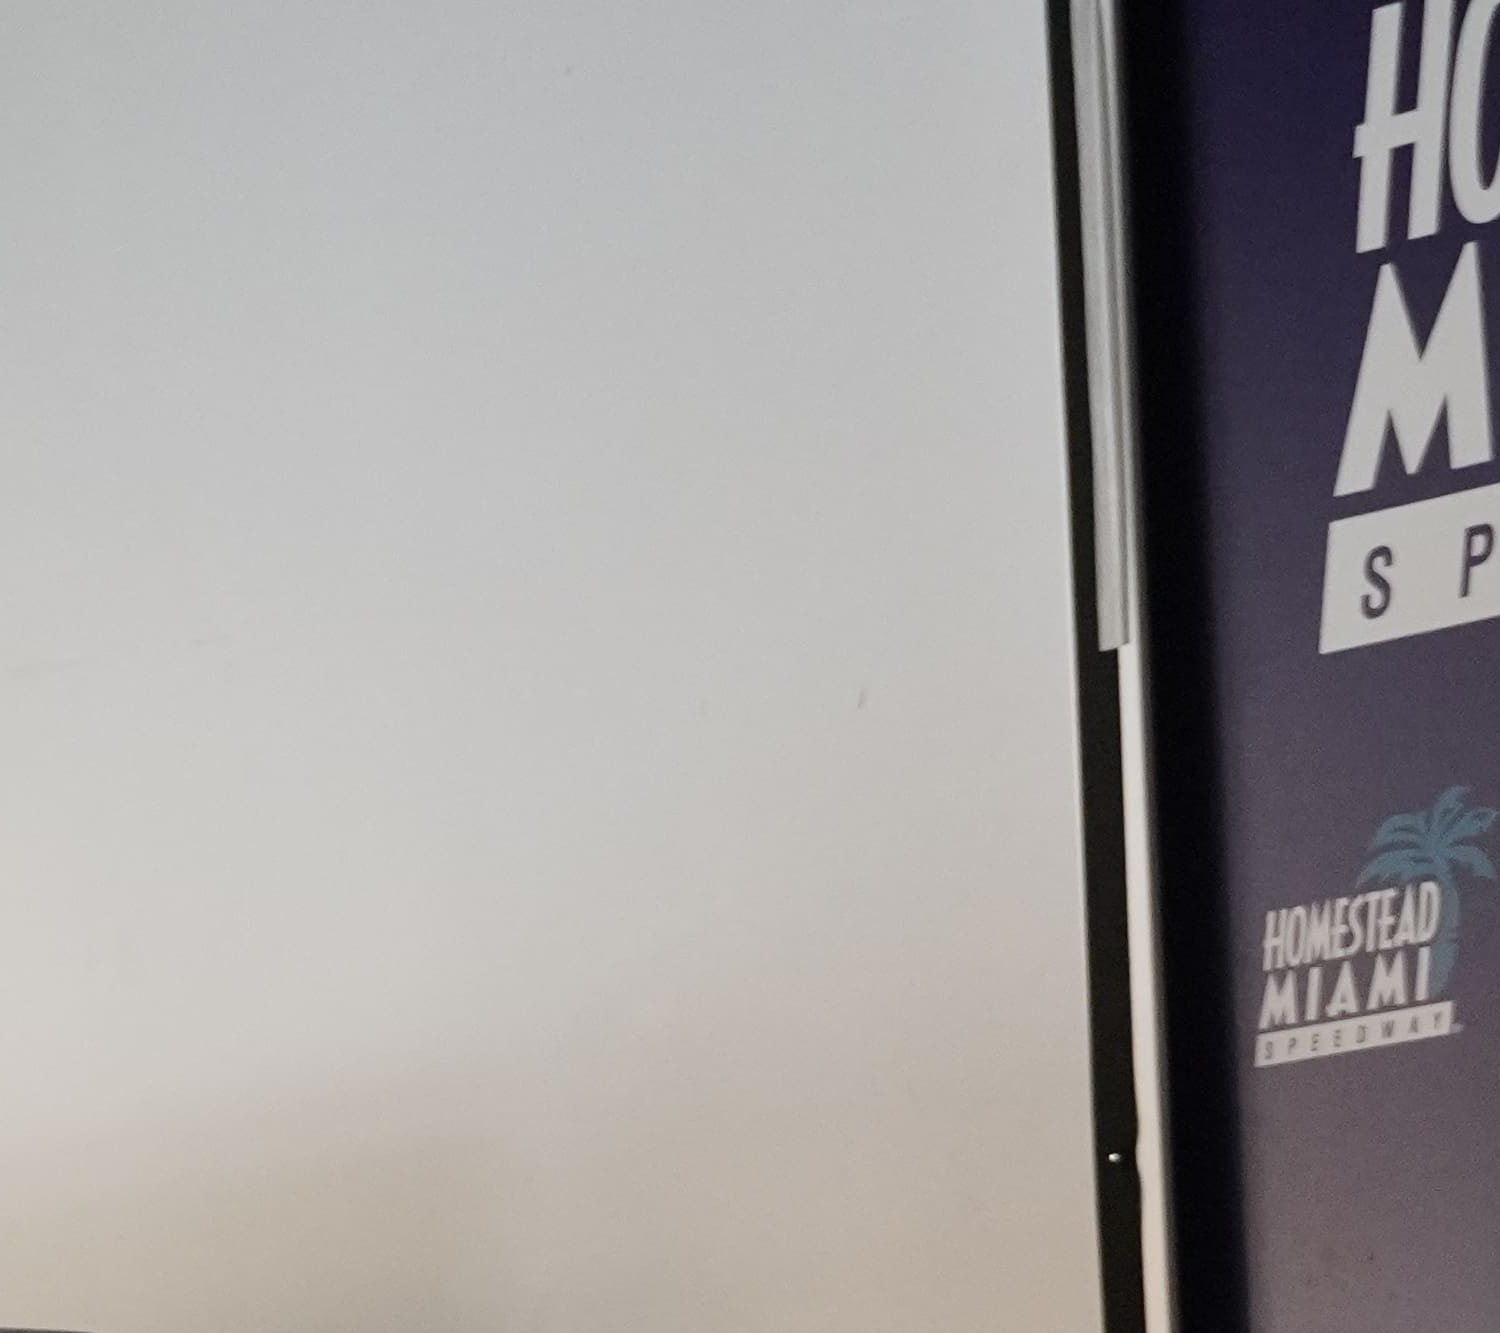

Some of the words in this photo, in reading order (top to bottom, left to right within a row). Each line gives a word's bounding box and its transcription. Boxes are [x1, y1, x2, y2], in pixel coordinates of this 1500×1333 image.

[1262, 881, 1441, 971] HOMESTEAD
[1258, 946, 1431, 1030] MIAMI
[1264, 1011, 1444, 1060] SPEEDWAY
